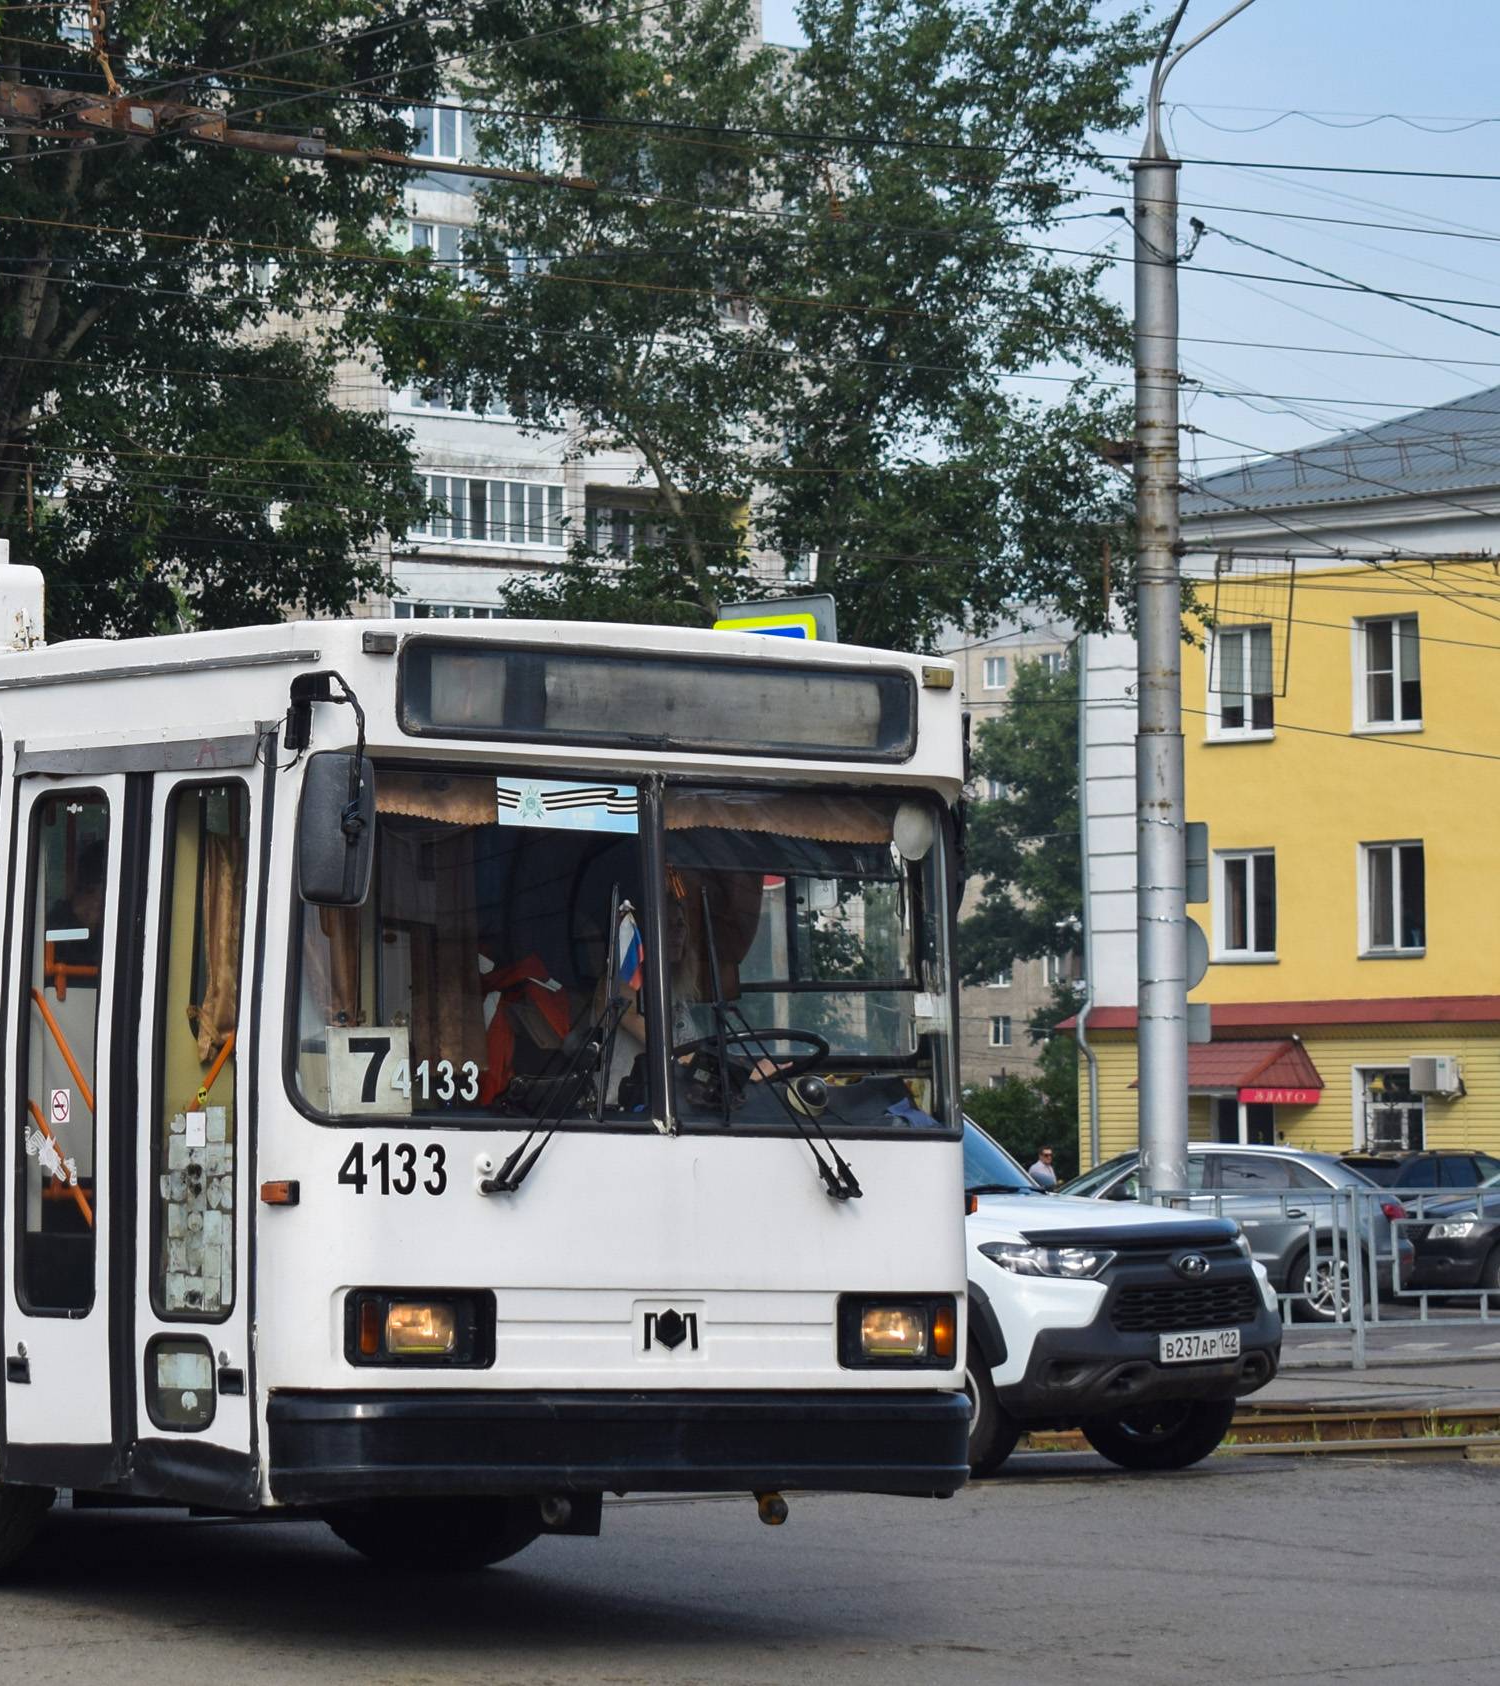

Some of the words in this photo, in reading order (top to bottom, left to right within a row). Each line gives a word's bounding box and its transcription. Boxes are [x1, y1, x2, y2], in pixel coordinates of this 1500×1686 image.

[348, 1037, 391, 1103] 7
[391, 1058, 479, 1101] 4133
[338, 1142, 447, 1196] 4133
